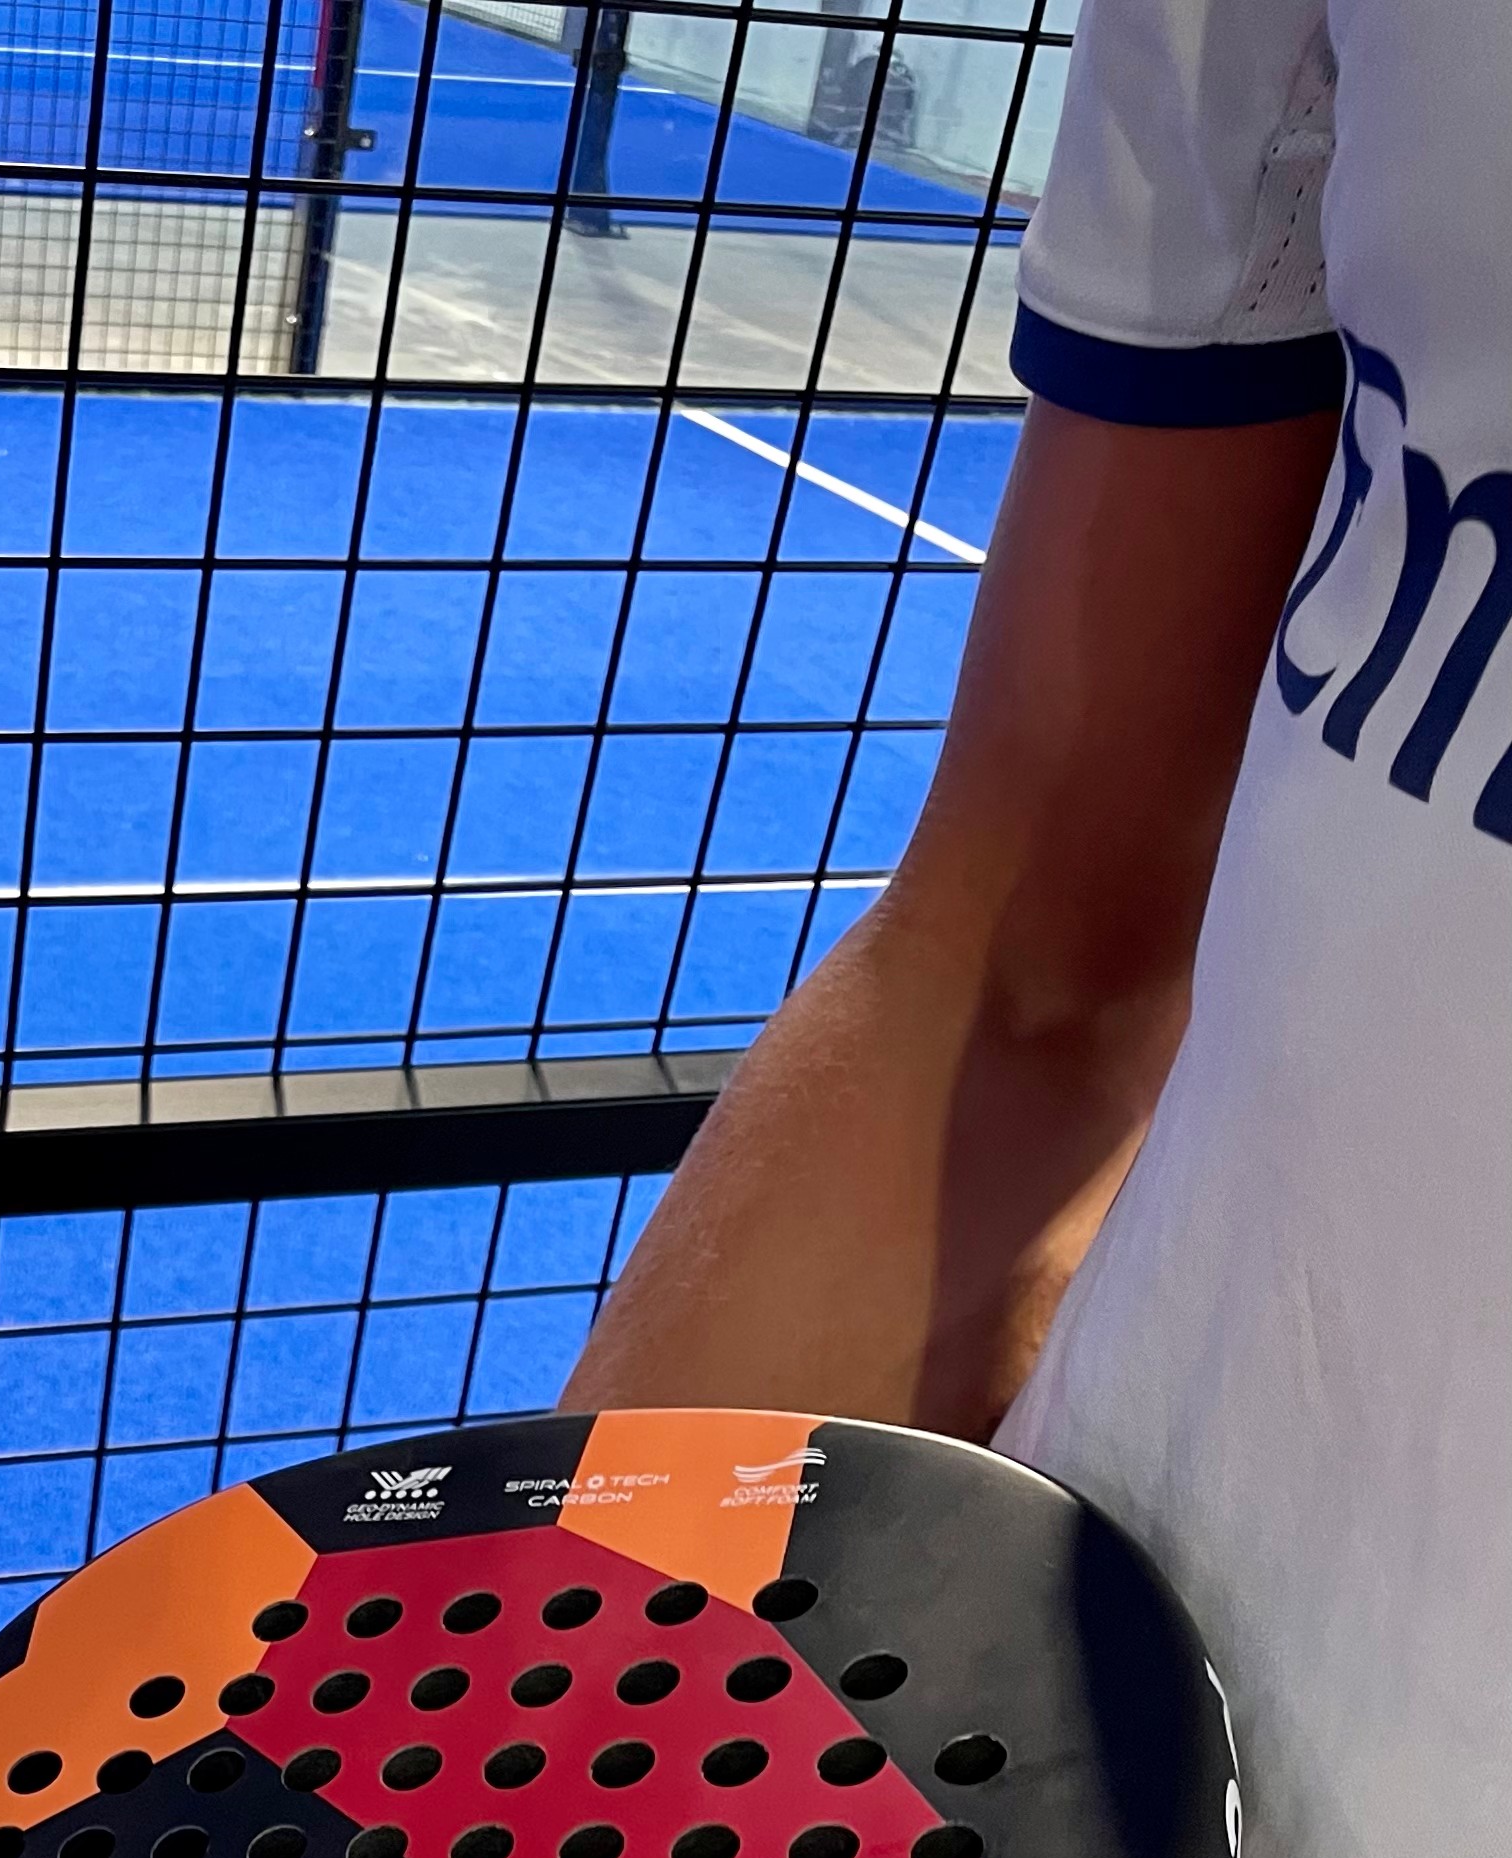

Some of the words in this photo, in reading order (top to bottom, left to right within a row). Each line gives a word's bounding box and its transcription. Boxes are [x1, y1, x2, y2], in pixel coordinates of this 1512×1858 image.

[504, 1479, 582, 1493] SPIRAL
[610, 1474, 670, 1487] TECH
[734, 1483, 820, 1499] COMFORT
[528, 1492, 633, 1507] CARBON
[720, 1496, 766, 1508] SOFT
[767, 1493, 818, 1505] FOAM
[343, 1512, 384, 1522] HOLE
[384, 1510, 440, 1521] DESIGN
